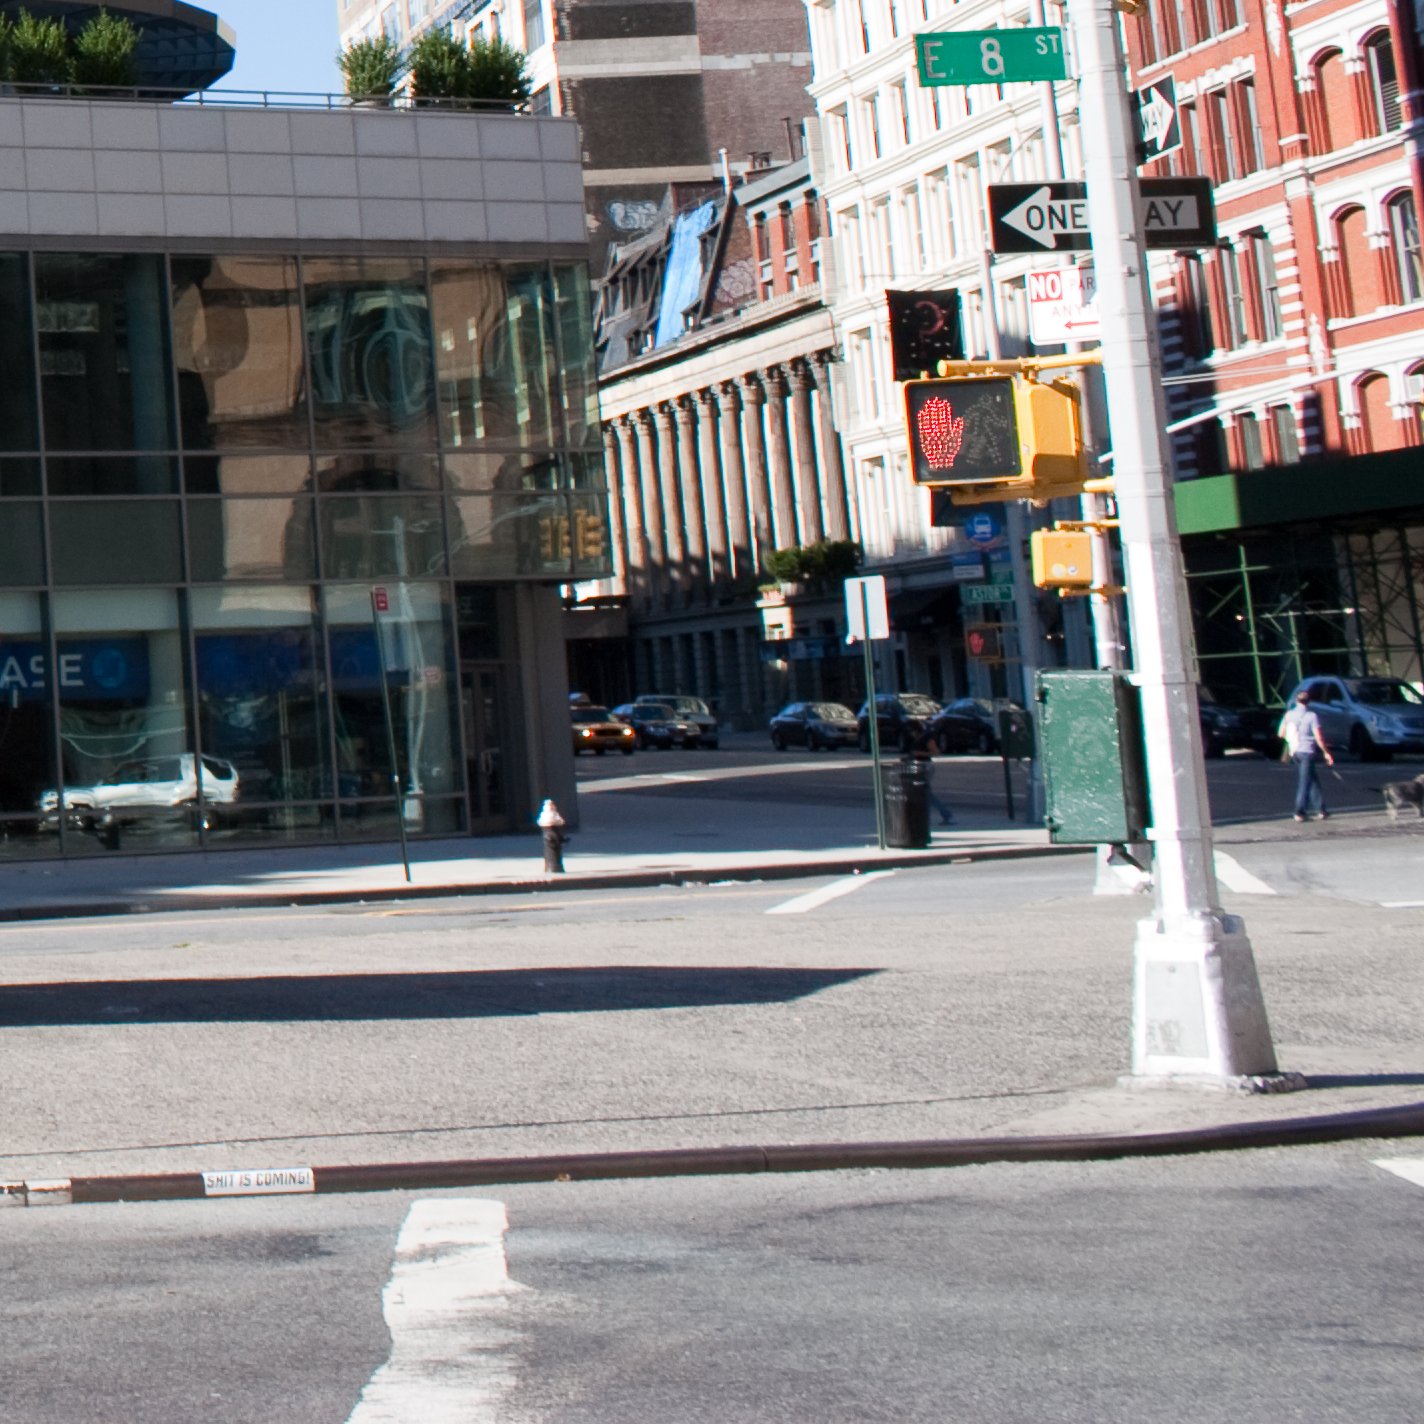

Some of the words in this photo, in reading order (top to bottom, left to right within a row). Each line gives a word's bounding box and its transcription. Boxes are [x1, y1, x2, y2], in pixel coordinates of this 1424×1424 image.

[923, 40, 947, 80] E
[980, 36, 1005, 78] 8
[1035, 34, 1061, 56] ST
[1025, 202, 1088, 231] ONE
[1144, 199, 1183, 227] AY
[1031, 273, 1061, 300] NO
[207, 1173, 234, 1189] SHIT
[239, 1172, 251, 1187] IS
